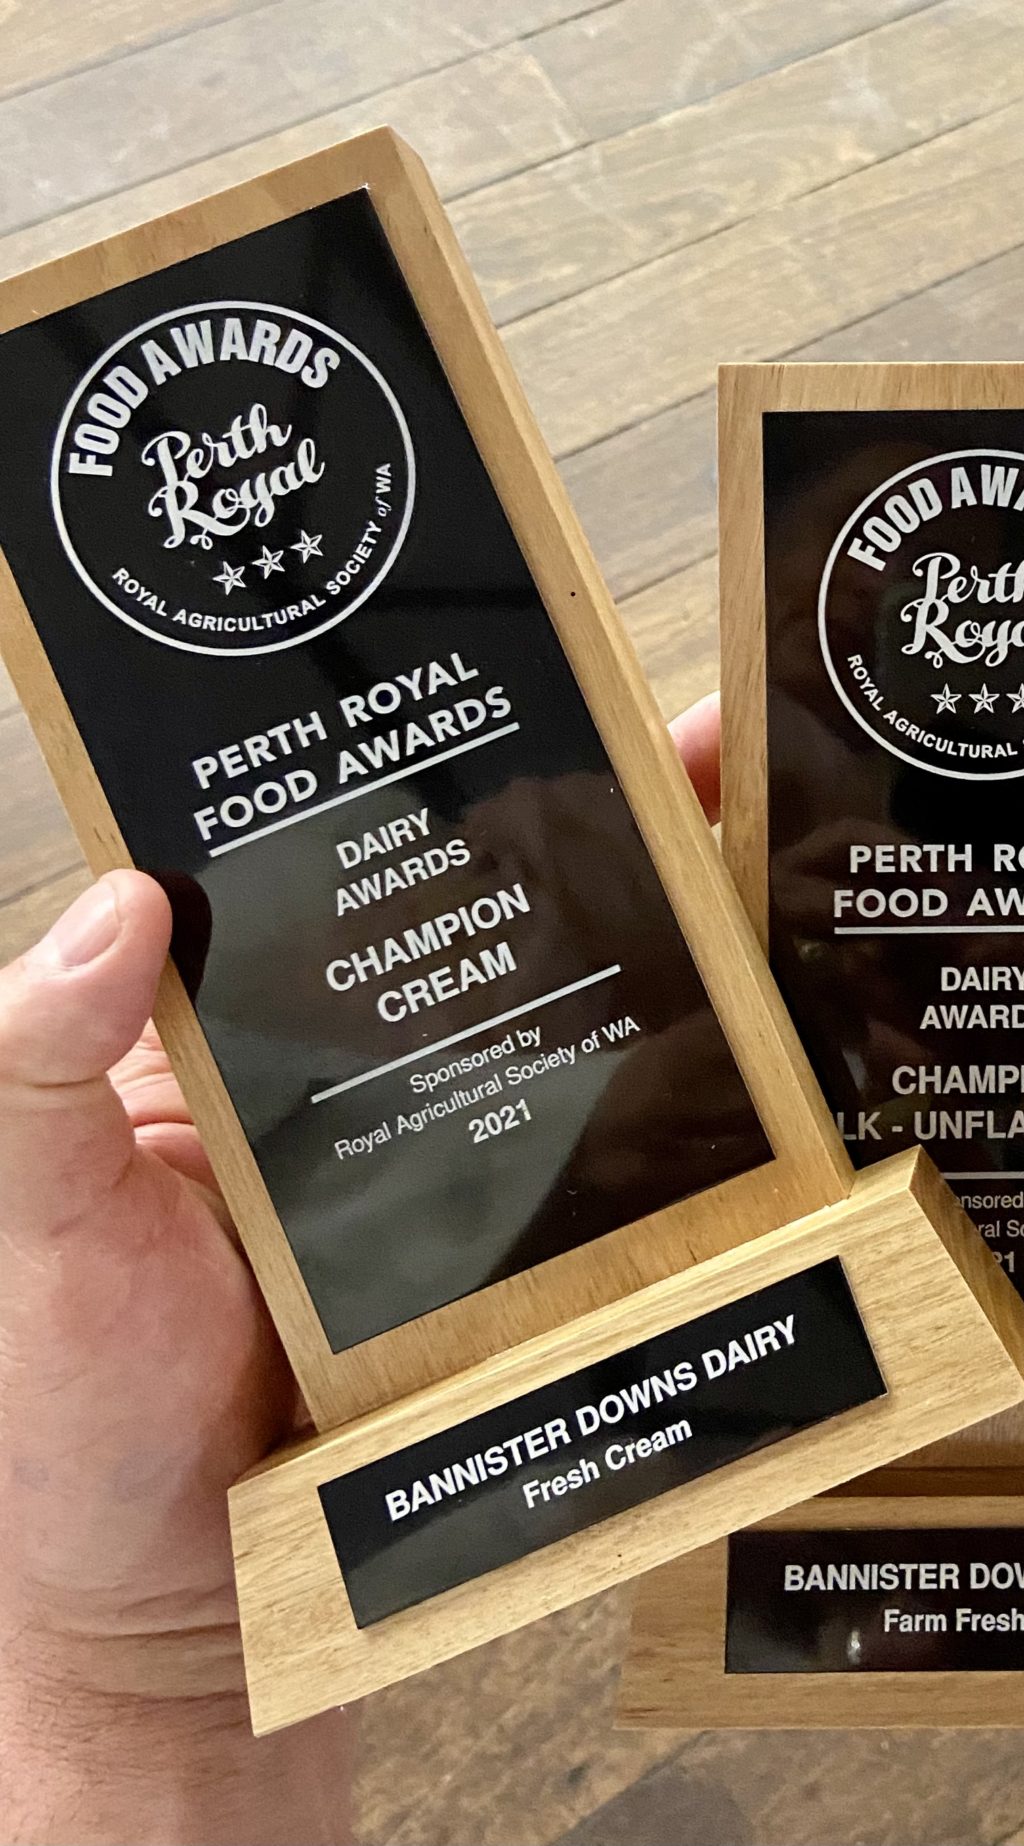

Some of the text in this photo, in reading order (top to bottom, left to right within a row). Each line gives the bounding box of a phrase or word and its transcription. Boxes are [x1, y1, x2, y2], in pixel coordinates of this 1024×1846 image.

[68, 318, 341, 476] FOOD AWARDS
[141, 403, 292, 484] Perth
[148, 437, 325, 549] Royal
[847, 478, 943, 571] FOOD
[112, 462, 393, 632] ROYAL AGRICULTURAL SOCIETY of WA
[192, 652, 479, 790] PERTH ROYAL
[847, 654, 883, 711] ROYAL
[883, 709, 1018, 759] AGRICULTURAL
[194, 686, 512, 840] FOOD AWARDS
[336, 808, 432, 869] DAIRY
[336, 839, 471, 916] AWARDS
[850, 844, 972, 873] PERTH
[325, 883, 531, 992] CHAMPION
[834, 888, 948, 918] FOOD
[377, 941, 517, 1022] CREAM
[334, 1016, 640, 1159] Royal Agricultural Society of WA
[409, 1026, 542, 1095] Sponsored by
[468, 1098, 532, 1143] 2021
[837, 1112, 882, 1140] LK
[892, 1125, 903, 1133] -
[958, 1191, 1024, 1210] nsored
[384, 1314, 795, 1521] BANNISTER DOWNS DAIRY
[522, 1419, 693, 1509] Fresh Cream
[784, 1563, 960, 1591] BANNISTER
[883, 1609, 947, 1633] Farm
